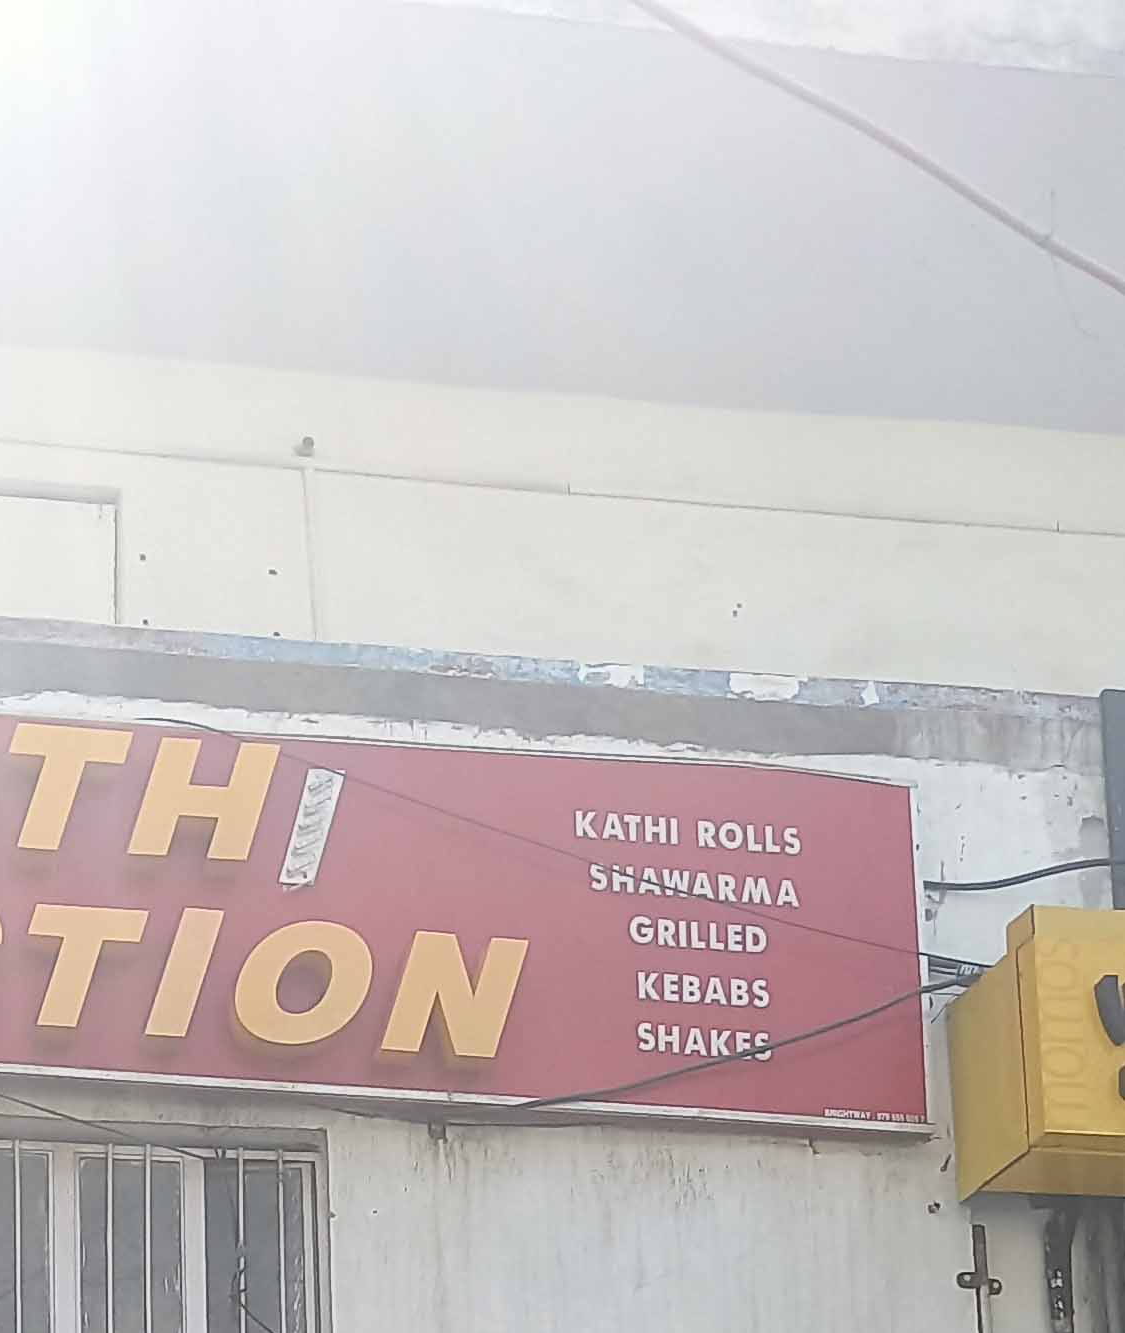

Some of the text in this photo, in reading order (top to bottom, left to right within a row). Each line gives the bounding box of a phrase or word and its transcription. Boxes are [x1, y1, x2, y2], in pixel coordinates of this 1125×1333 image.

[574, 810, 802, 856] KATHI ROLLS
[589, 863, 801, 908] SHAWARMA
[629, 915, 768, 953] GRILLED
[636, 971, 771, 1009] KEBABS
[636, 1022, 773, 1062] SHAKES
